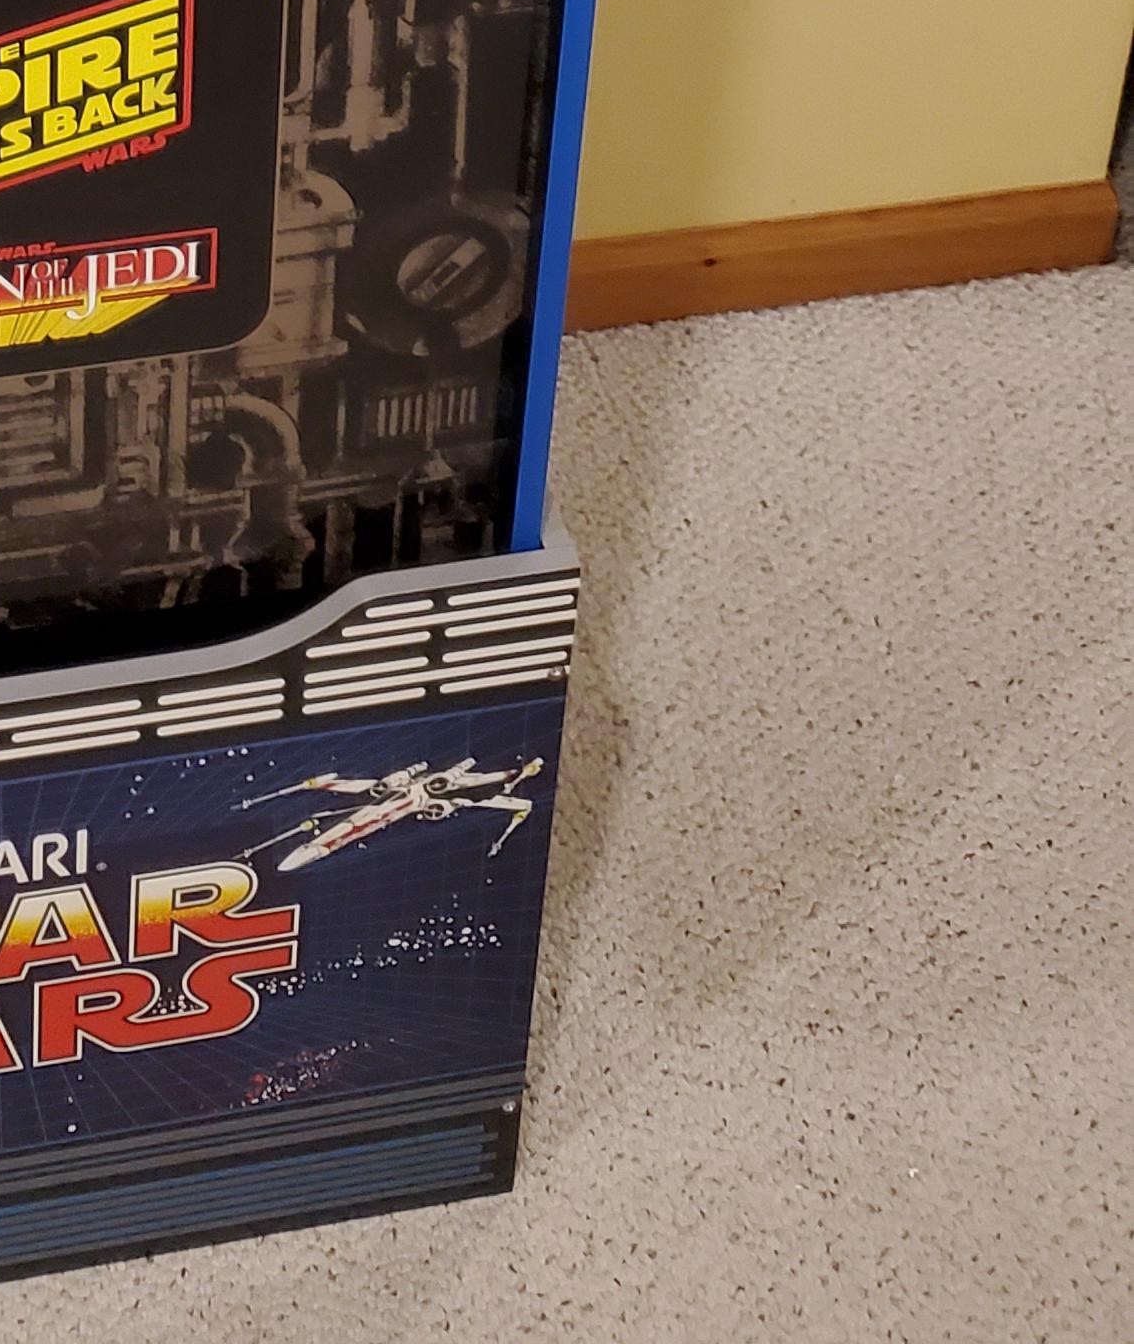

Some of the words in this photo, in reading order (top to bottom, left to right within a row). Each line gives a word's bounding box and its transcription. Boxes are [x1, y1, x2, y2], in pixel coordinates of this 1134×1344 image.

[42, 69, 178, 146] BACK
[78, 129, 168, 174] WARS
[30, 257, 69, 280] OF
[65, 240, 203, 321] JEDI
